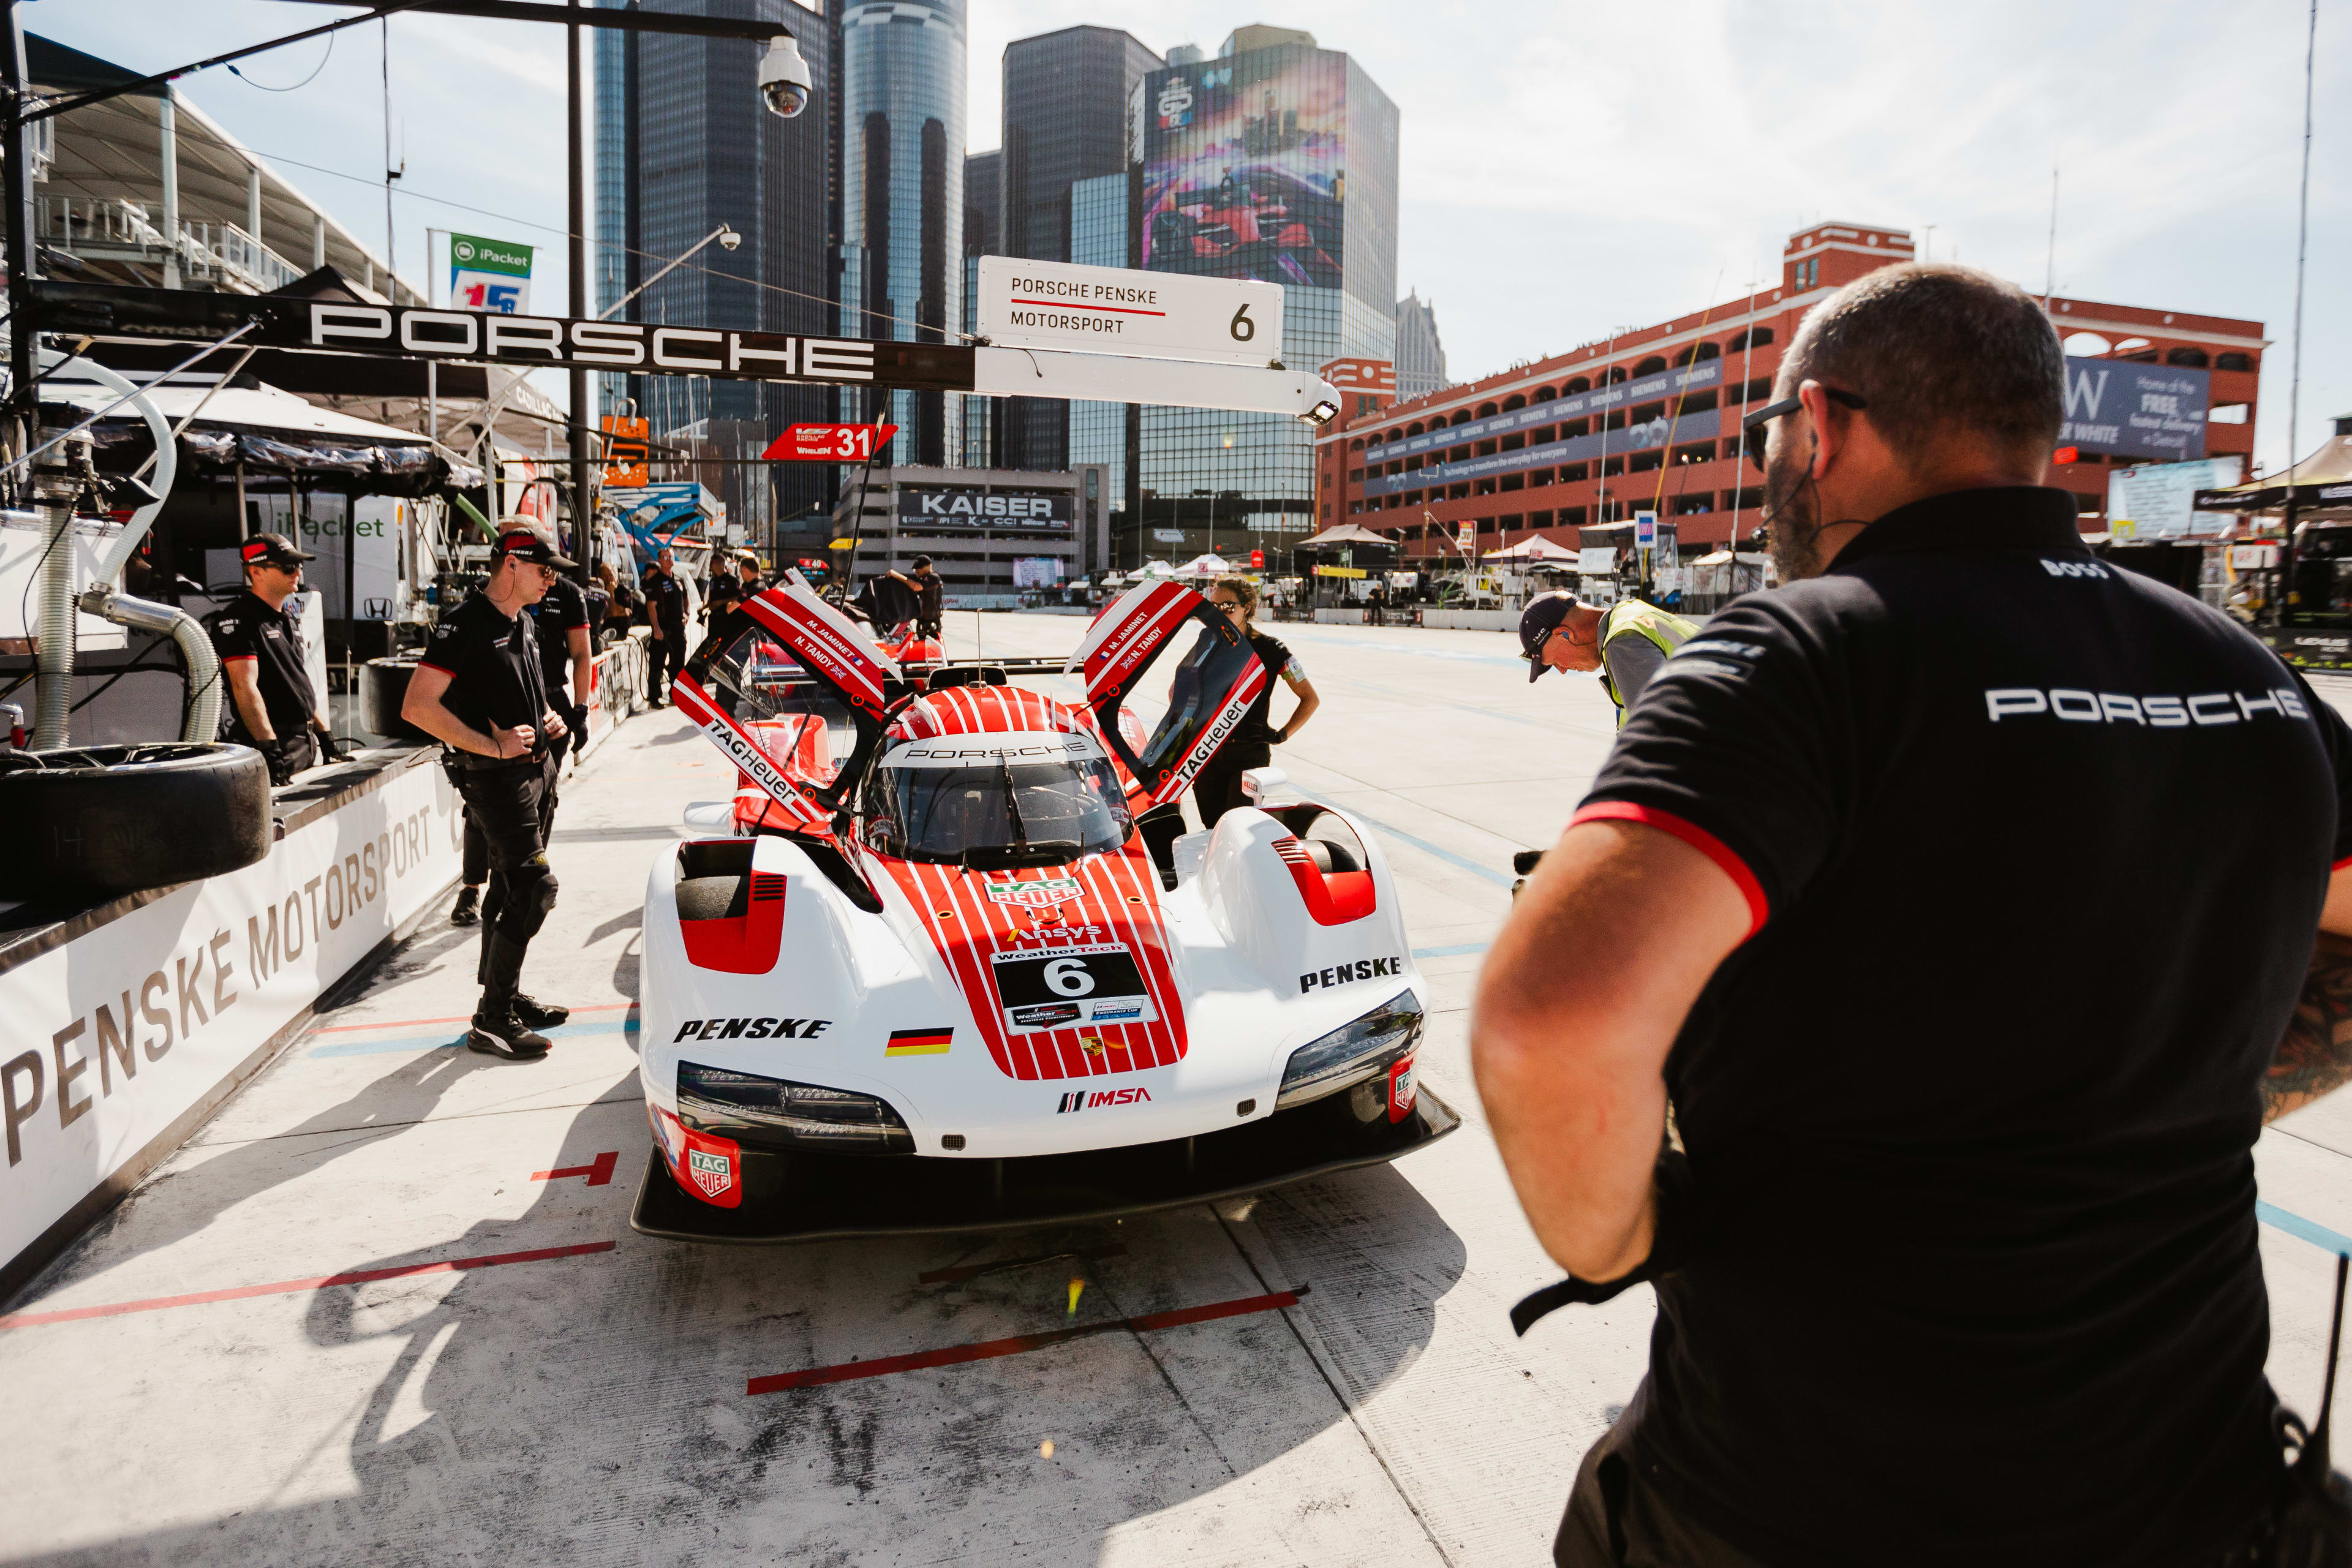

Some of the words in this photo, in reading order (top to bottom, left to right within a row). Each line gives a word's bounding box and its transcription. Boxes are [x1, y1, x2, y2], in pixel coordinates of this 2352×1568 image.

[480, 248, 528, 267] iPacket
[1011, 277, 1090, 299] PORSCHE
[1095, 285, 1157, 306] PENSKE
[1011, 311, 1124, 334] MOTORSPORT
[1230, 303, 1255, 342] 6
[311, 303, 875, 381] PORSCHE
[1519, 409, 1547, 424] SIEMENS
[1553, 400, 1583, 416] SIEMENS
[1590, 390, 1623, 407] SIEMENS
[1630, 379, 1667, 397] SIEMENS
[1675, 366, 1716, 387] SIEMENS
[2141, 393, 2179, 416] FREE
[837, 428, 869, 456] 31
[2074, 423, 2120, 445] WHITE
[796, 446, 831, 455] WHELEN
[922, 494, 1052, 518] KAISER
[811, 559, 822, 568] 40
[2039, 559, 2109, 579] BOSS
[807, 620, 818, 630] M.
[817, 628, 855, 658] JAMINET
[1109, 641, 1121, 650] M.
[1118, 611, 1148, 641] JAMINET
[1130, 650, 1142, 658] N.
[1137, 626, 1163, 650] TANDY
[794, 635, 805, 647] N.
[804, 643, 835, 668] TANDY
[1985, 687, 2309, 727] PORSCHE
[904, 741, 1088, 760] PORSCHE
[993, 880, 1071, 892] TAG
[995, 889, 1077, 905] HEUER
[1006, 925, 1102, 942] Ansys
[997, 945, 1121, 960] WeatherTech
[1, 927, 238, 1167] PENSKE
[247, 805, 431, 990] MOTORSPORT
[1044, 958, 1095, 997] 6
[1300, 956, 1401, 993] PENSKE
[673, 1017, 833, 1043] PENSKE
[1088, 1087, 1152, 1108] IMSA
[692, 1153, 726, 1172] TAG
[693, 1169, 729, 1193] HEUER
